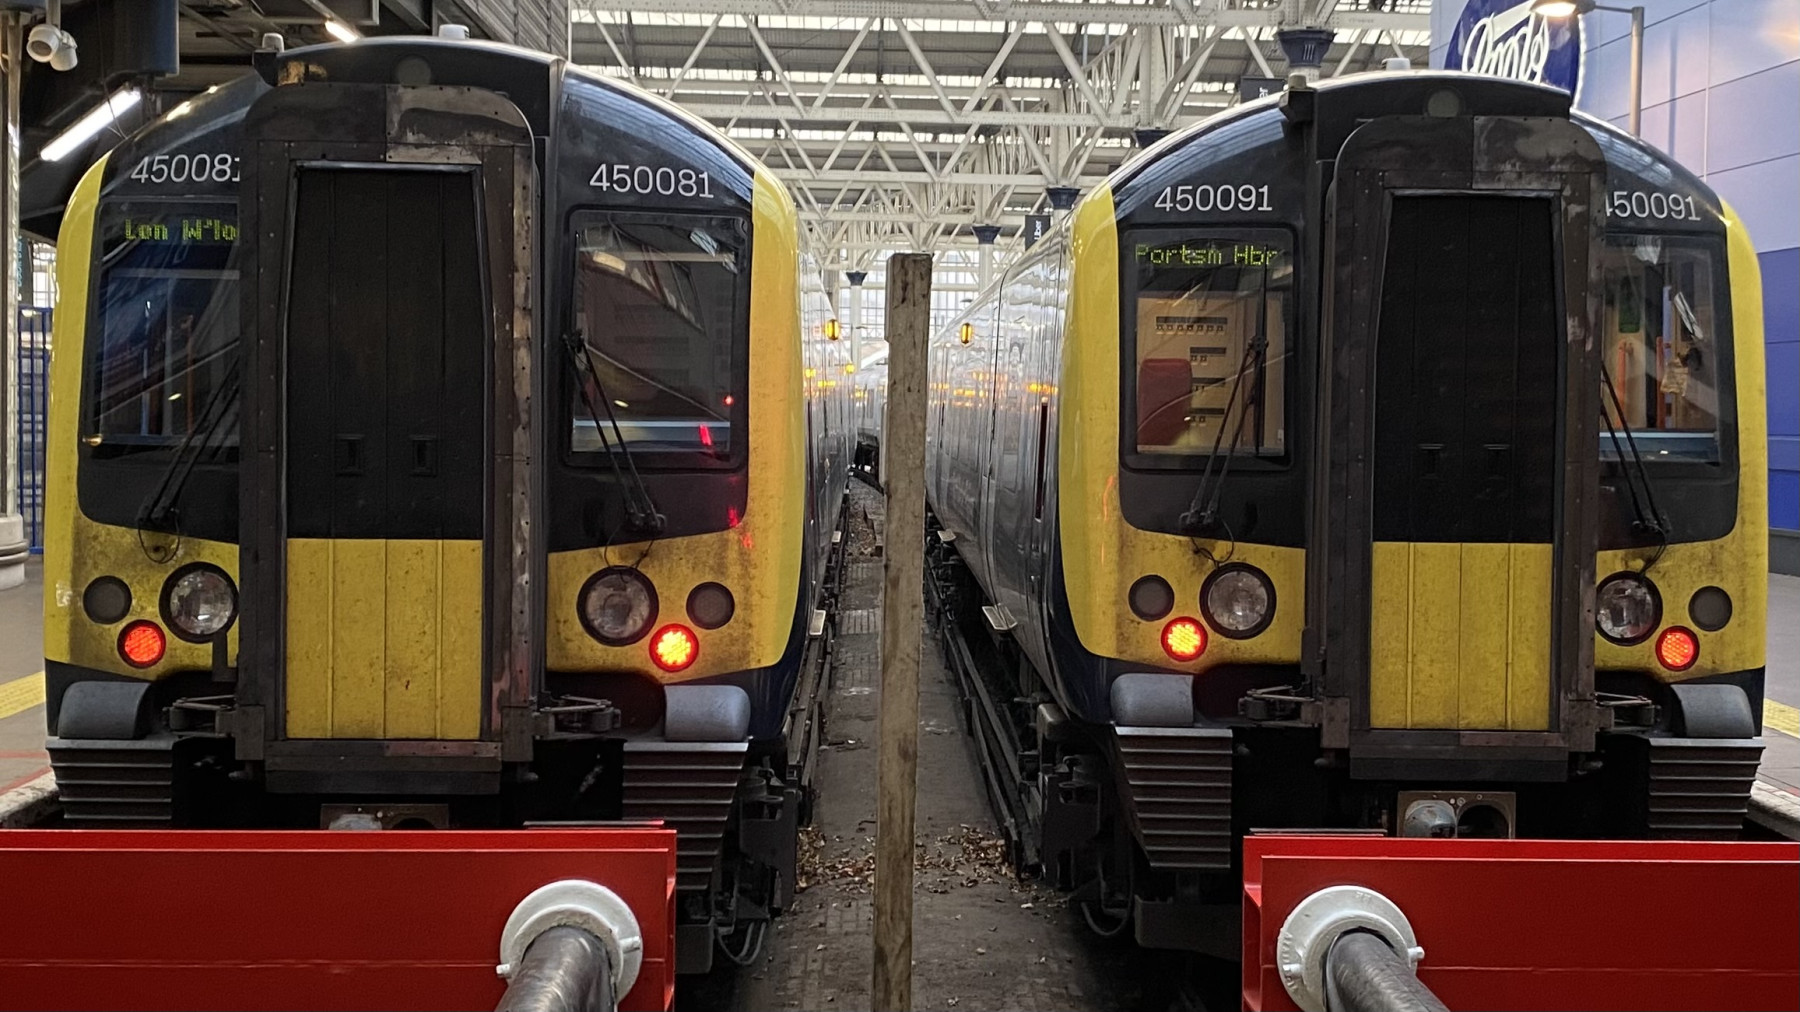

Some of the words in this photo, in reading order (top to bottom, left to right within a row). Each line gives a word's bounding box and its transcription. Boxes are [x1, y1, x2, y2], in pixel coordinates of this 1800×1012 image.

[589, 163, 714, 198] 450081
[1154, 184, 1273, 212] 450091
[125, 219, 168, 240] Lon
[1135, 244, 1222, 264] Portsm
[1234, 244, 1278, 265] Hbr
